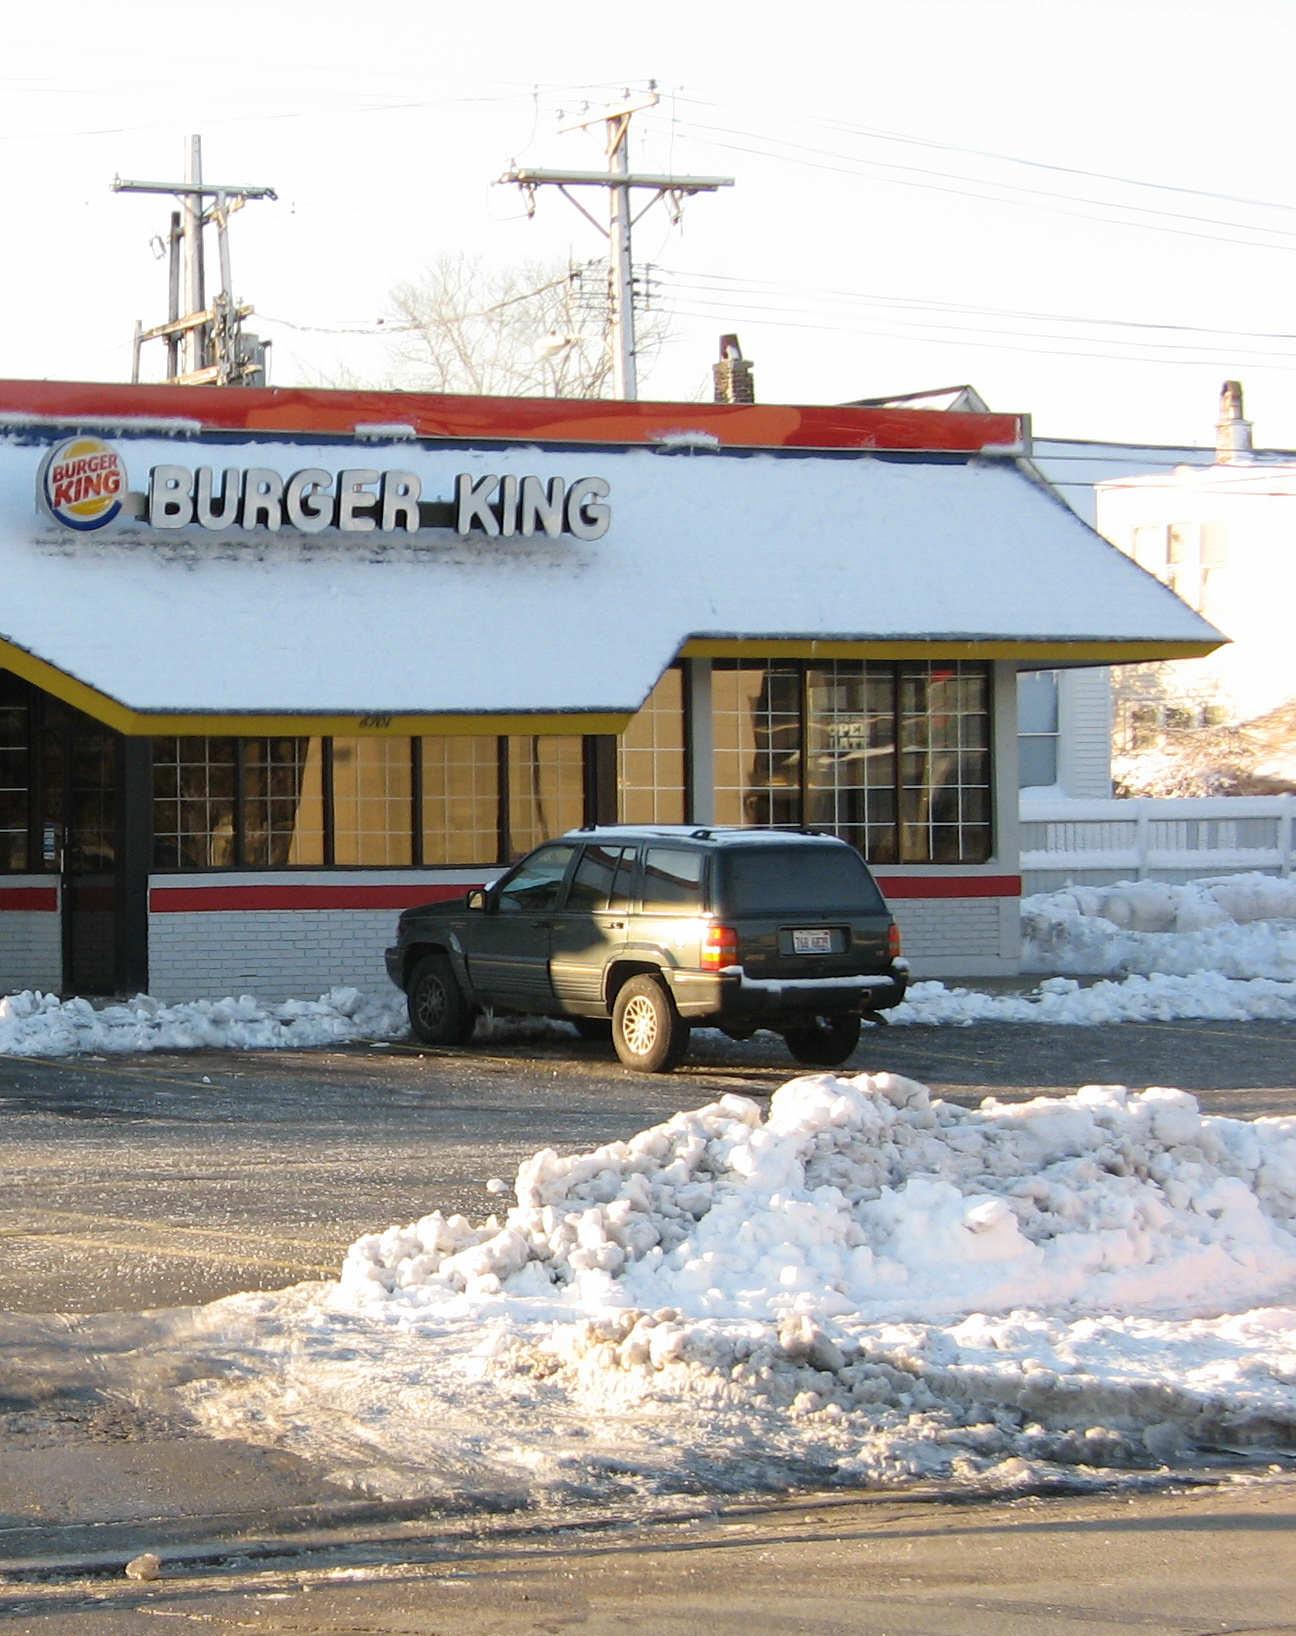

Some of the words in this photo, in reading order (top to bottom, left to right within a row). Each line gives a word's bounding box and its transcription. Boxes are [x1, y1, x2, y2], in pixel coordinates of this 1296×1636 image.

[52, 454, 118, 484] BURGER
[53, 470, 121, 508] KING
[148, 464, 423, 534] BURGER
[455, 473, 612, 542] KING
